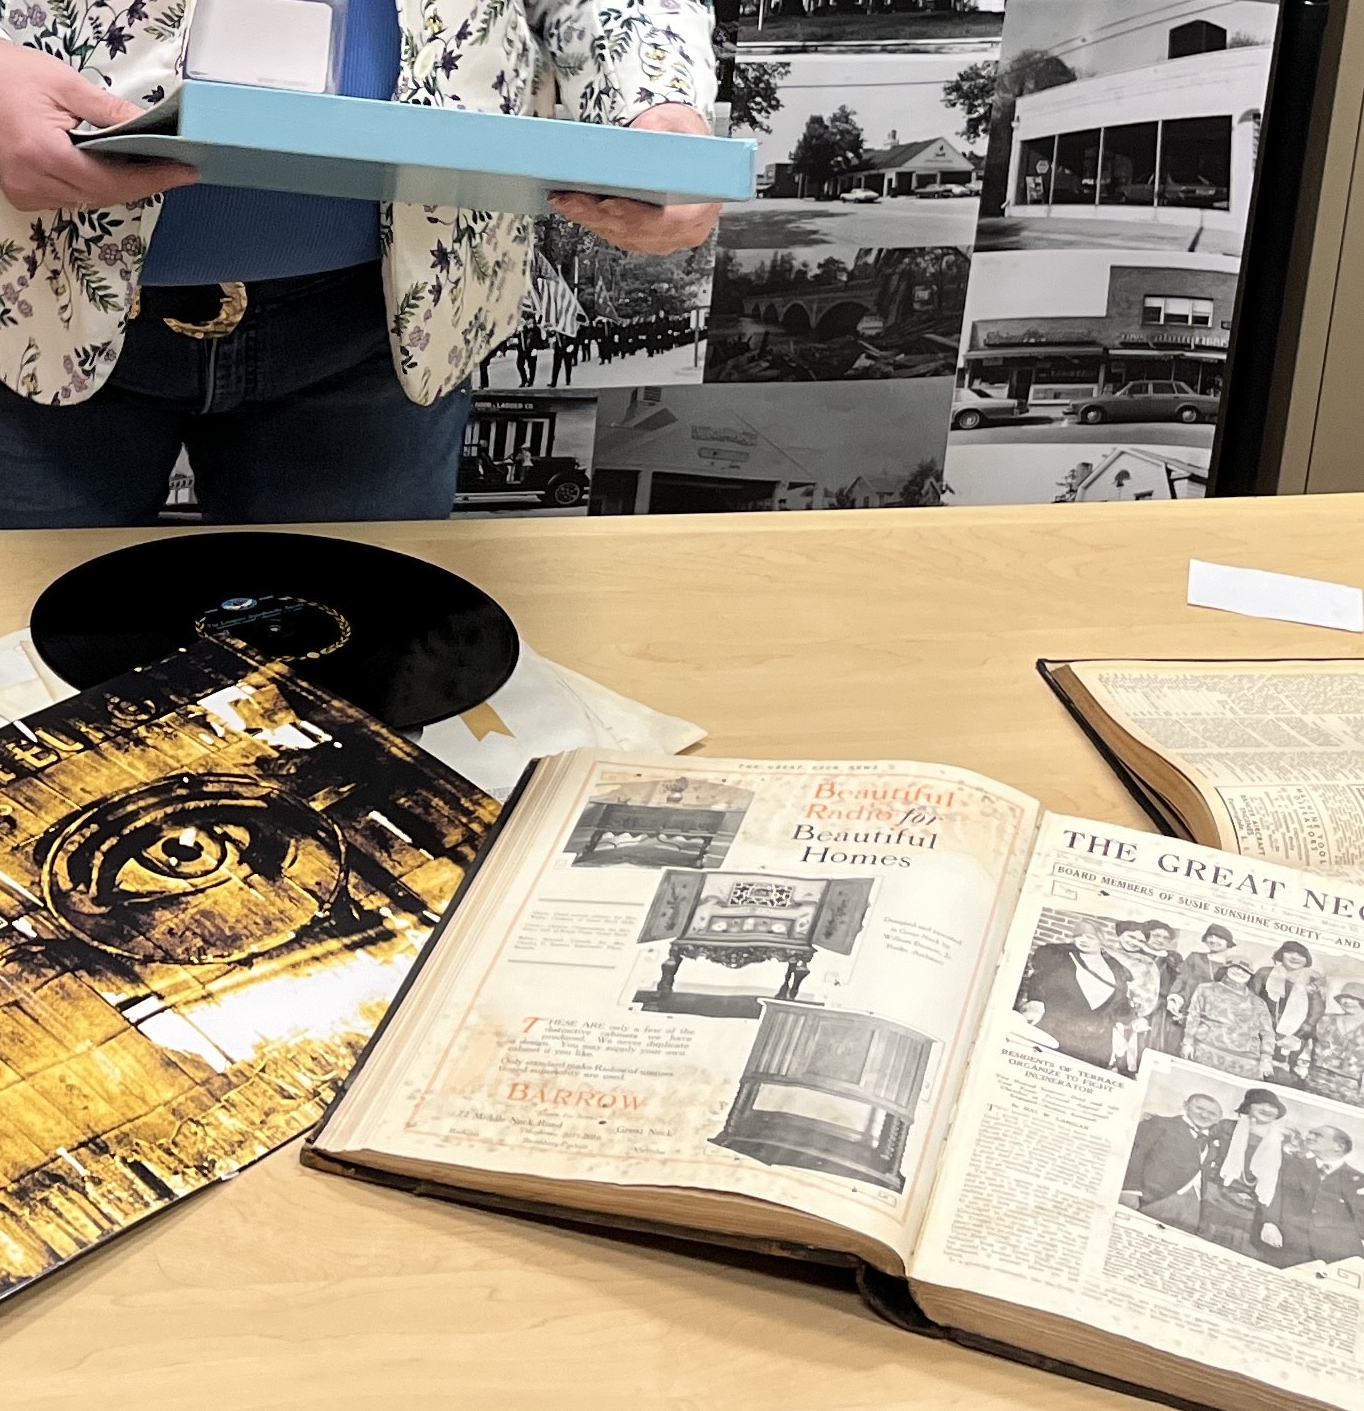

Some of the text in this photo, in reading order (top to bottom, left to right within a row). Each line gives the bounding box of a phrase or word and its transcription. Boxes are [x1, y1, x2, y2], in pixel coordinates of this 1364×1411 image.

[813, 781, 955, 808] Beautiful
[805, 803, 943, 826] Radio for
[792, 823, 938, 850] Beautiful
[1252, 820, 1266, 857] AIRCRAFT
[1317, 833, 1328, 865] TOOL
[801, 846, 911, 868] Homes
[1063, 829, 1137, 863] THE
[1157, 852, 1285, 900] GREAT
[1303, 888, 1364, 921] NE
[1057, 865, 1097, 883] BOARD
[1101, 875, 1154, 901] MEMBERS
[1159, 891, 1175, 903] OF
[1178, 896, 1210, 911] SUSIE
[1214, 904, 1270, 928] SUNSHINE
[1273, 921, 1322, 941] SOCIETY
[1335, 936, 1362, 950] AND
[1001, 1048, 1125, 1089] RESIDENTS OF TERRACE
[1008, 1058, 1114, 1093] ORGANIZE TO FIGHT
[1024, 1070, 1094, 1095] INCINERATOR
[507, 1082, 647, 1111] BARROW
